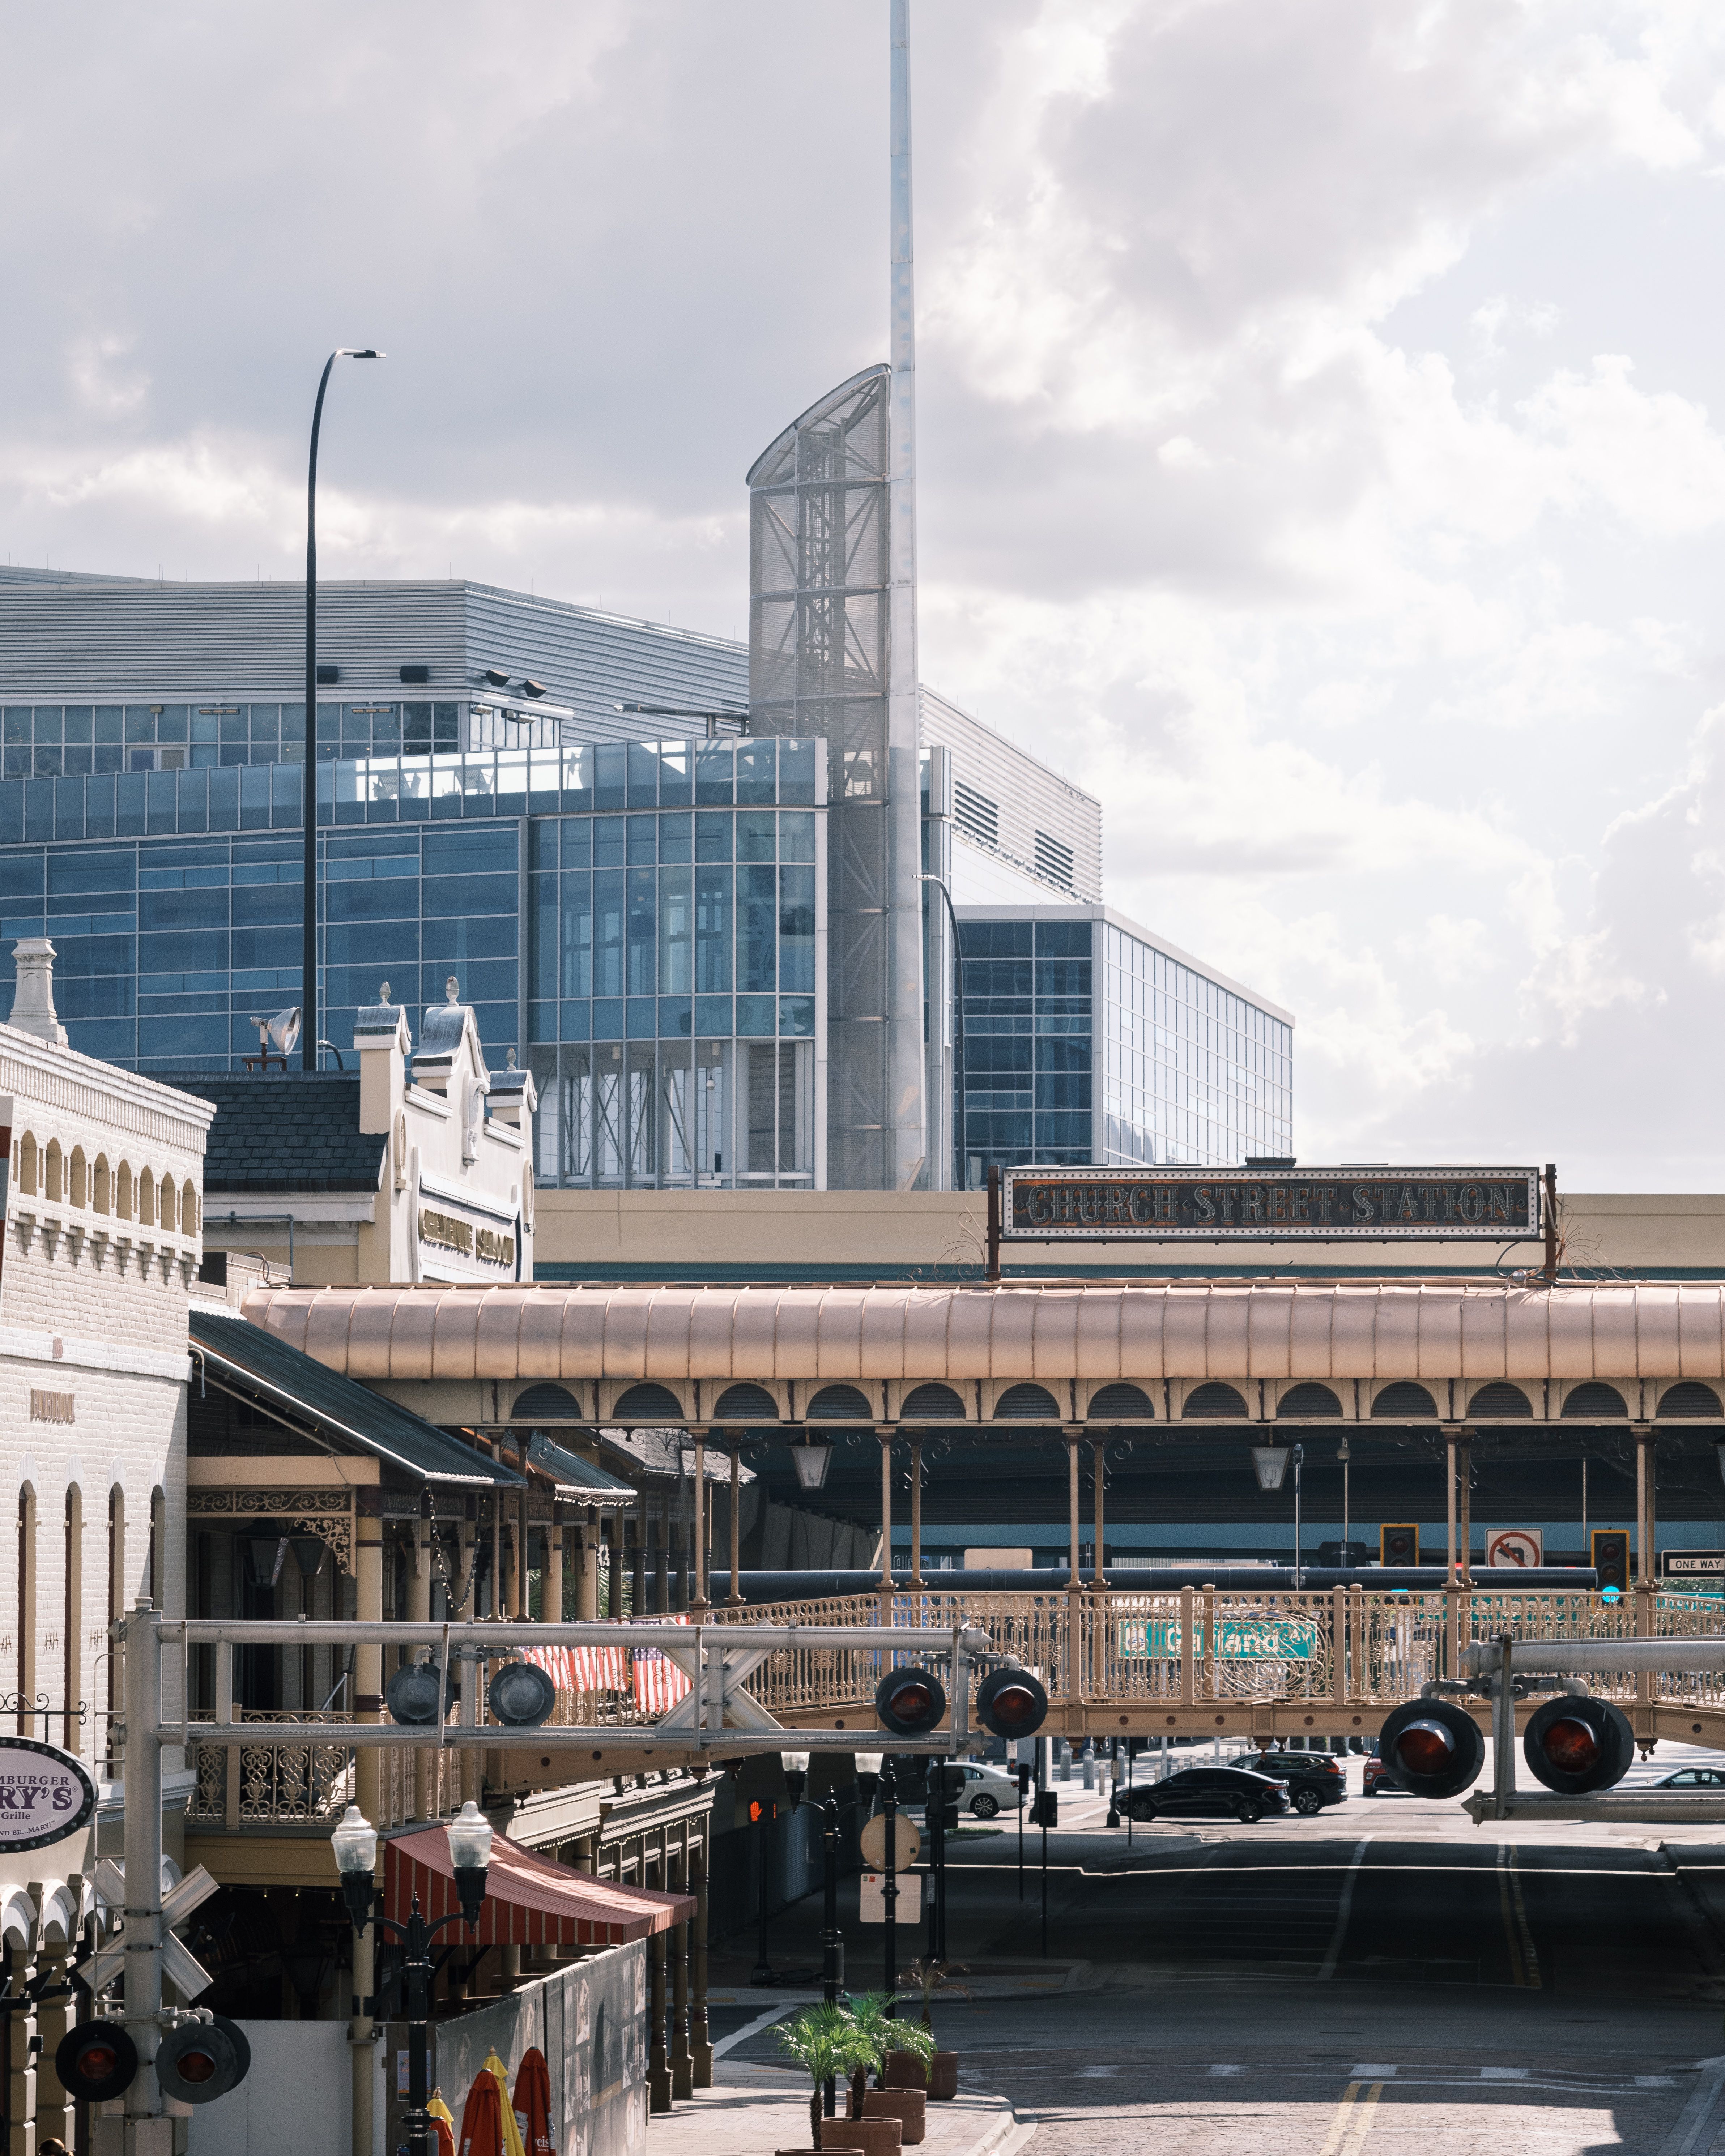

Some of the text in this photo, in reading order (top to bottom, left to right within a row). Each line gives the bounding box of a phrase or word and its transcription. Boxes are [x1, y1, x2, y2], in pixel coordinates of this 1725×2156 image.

[1026, 1184, 1514, 1222] CHURCH STREET STATION
[1676, 1560, 1721, 1569] ONE WAY
[1167, 1627, 1279, 1652] Galand
[1, 1811, 30, 1820] Grille
